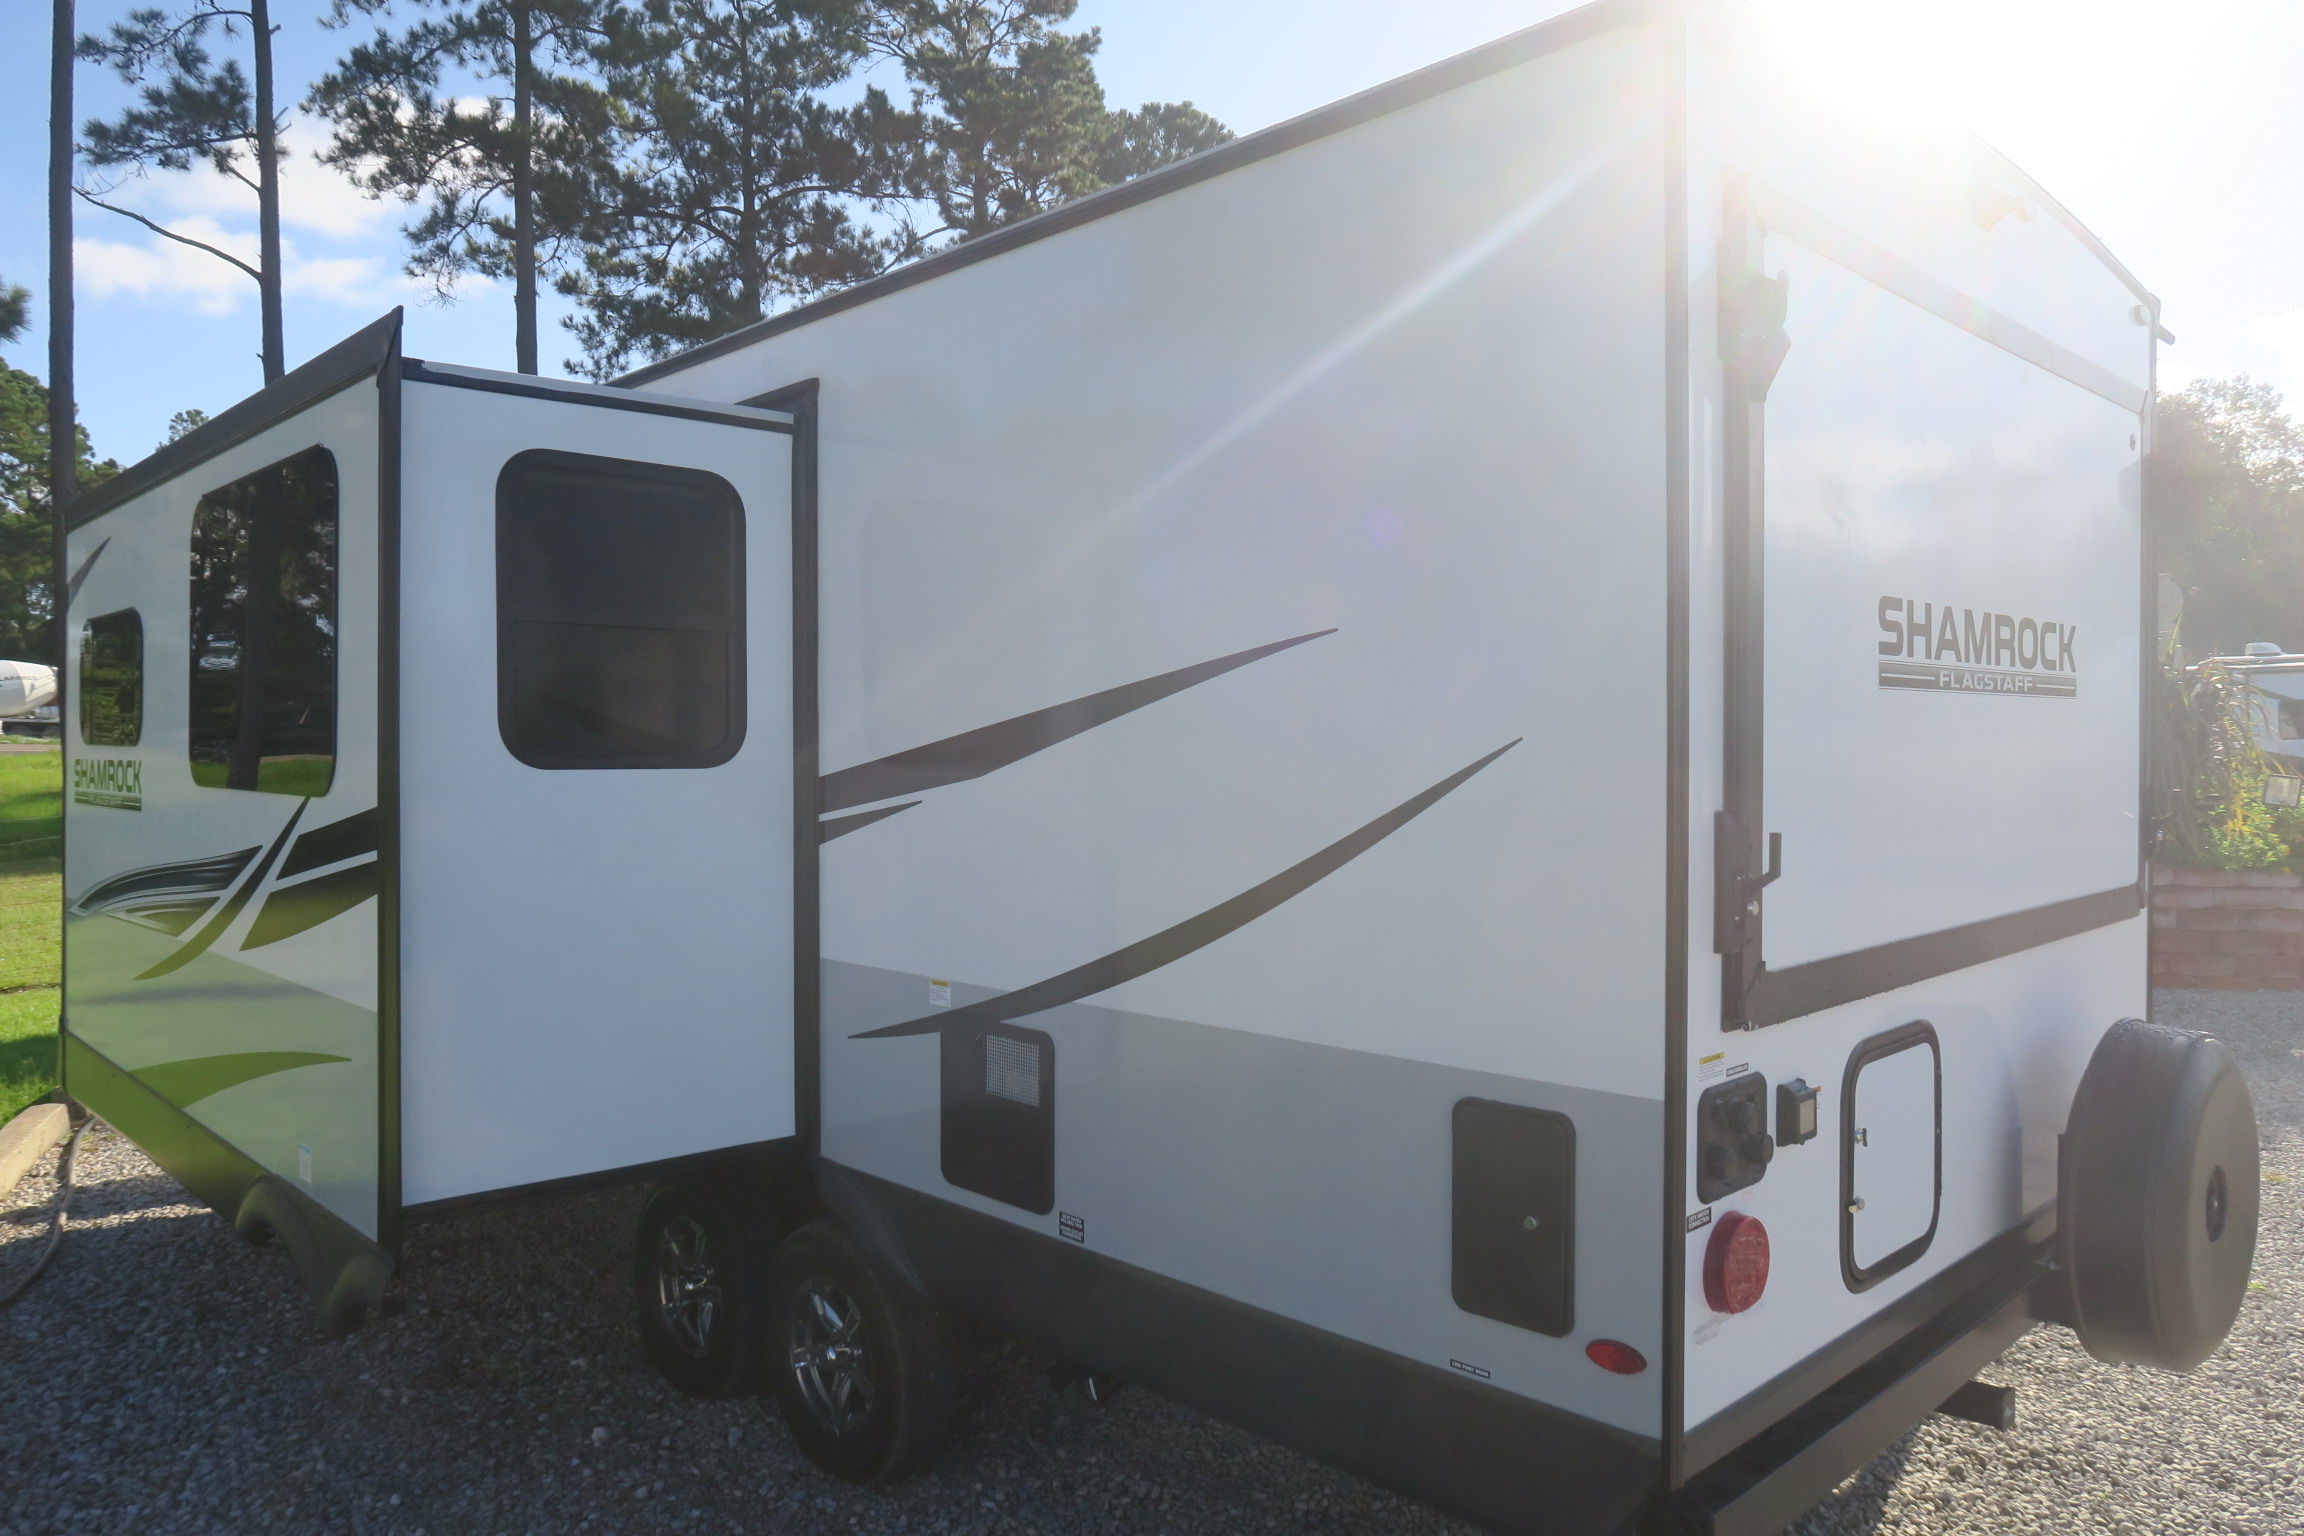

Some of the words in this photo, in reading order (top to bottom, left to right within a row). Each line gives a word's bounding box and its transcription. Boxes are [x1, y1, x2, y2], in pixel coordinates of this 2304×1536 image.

[1878, 595, 2077, 673] SHAMROCK
[1939, 670, 2033, 692] FLAGSTAFF
[74, 758, 142, 794] SHAMROCK
